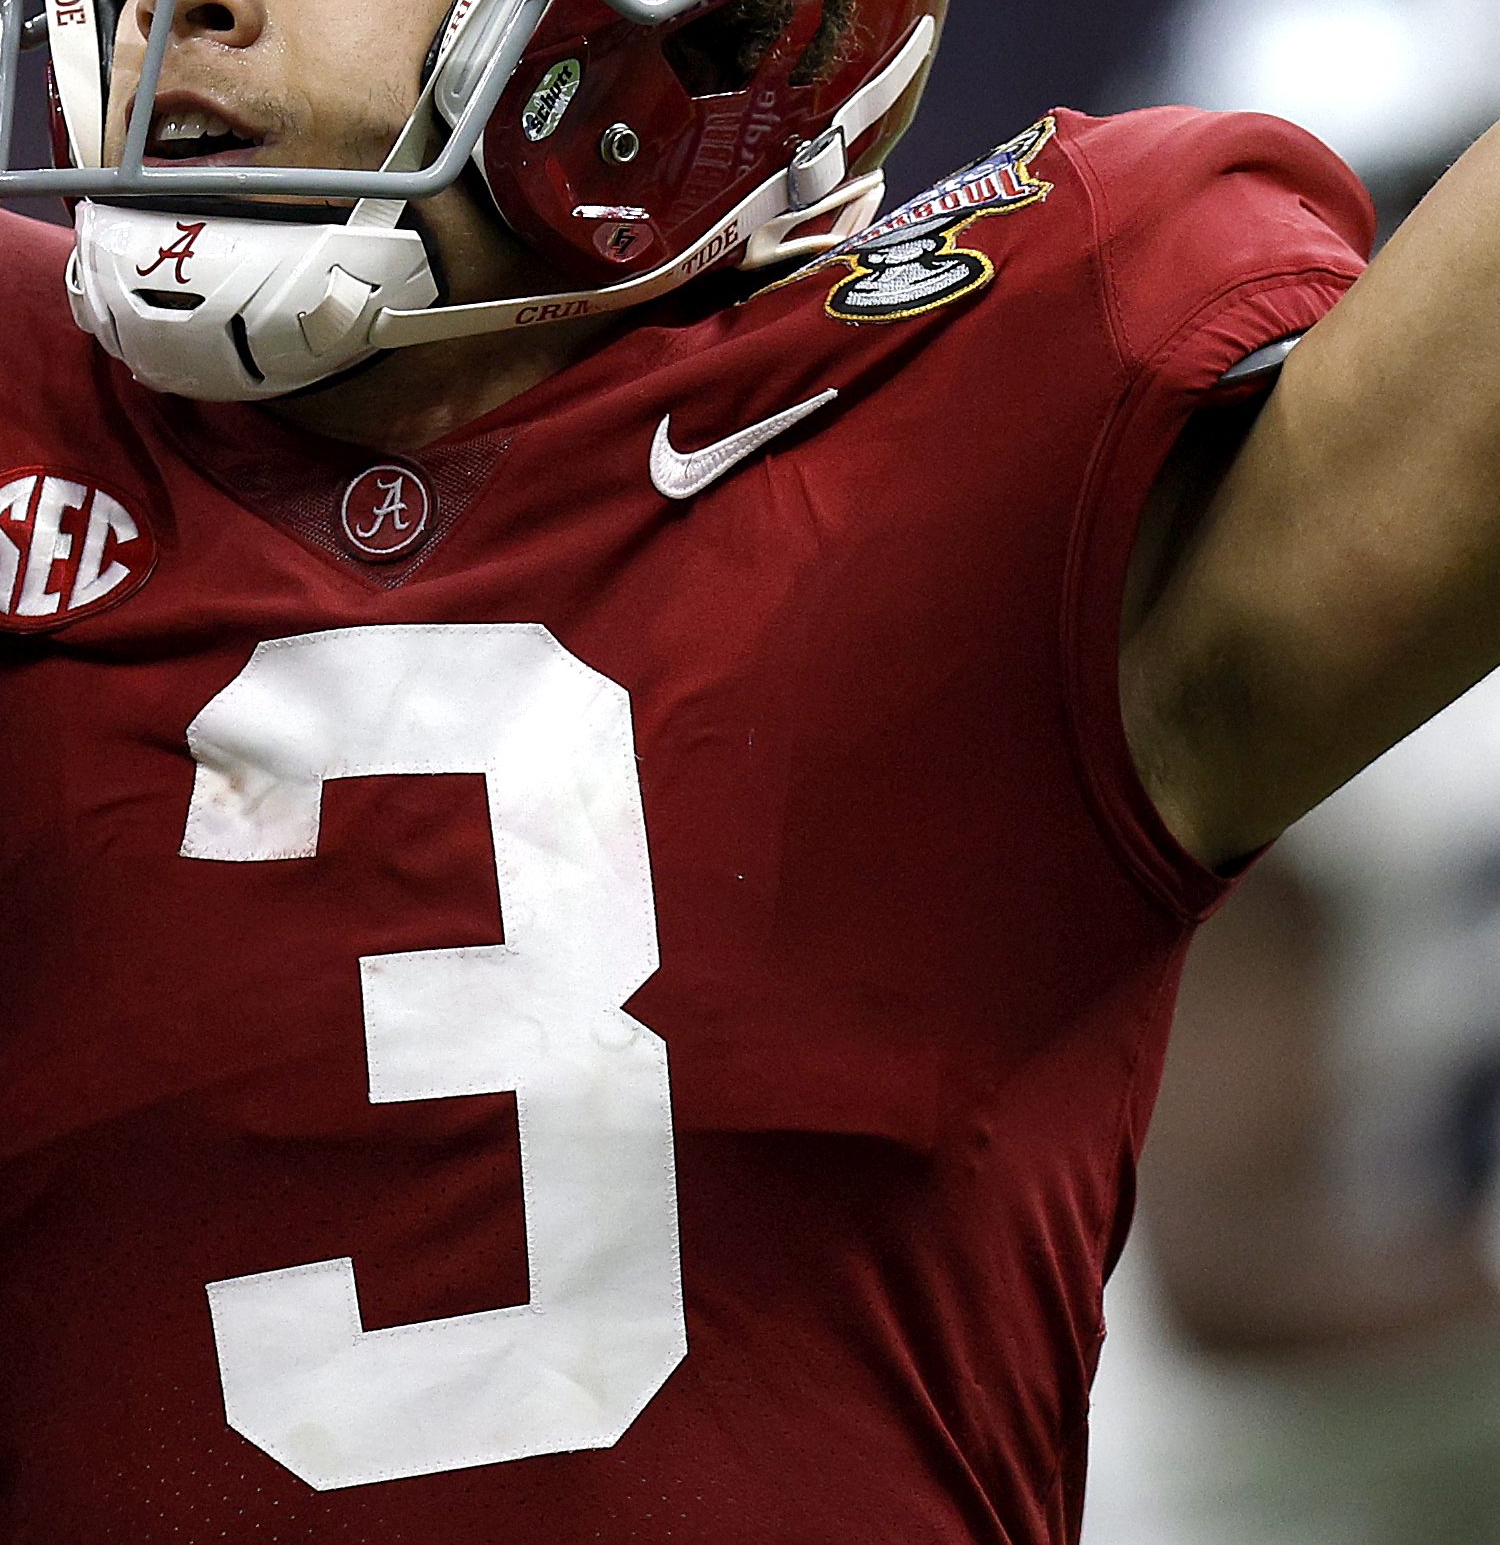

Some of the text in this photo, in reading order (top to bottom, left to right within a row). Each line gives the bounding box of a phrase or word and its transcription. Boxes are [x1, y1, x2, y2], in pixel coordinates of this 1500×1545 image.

[530, 65, 573, 134] schutt
[681, 218, 739, 275] TIDE
[355, 476, 411, 538] A
[181, 622, 688, 1492] 3
